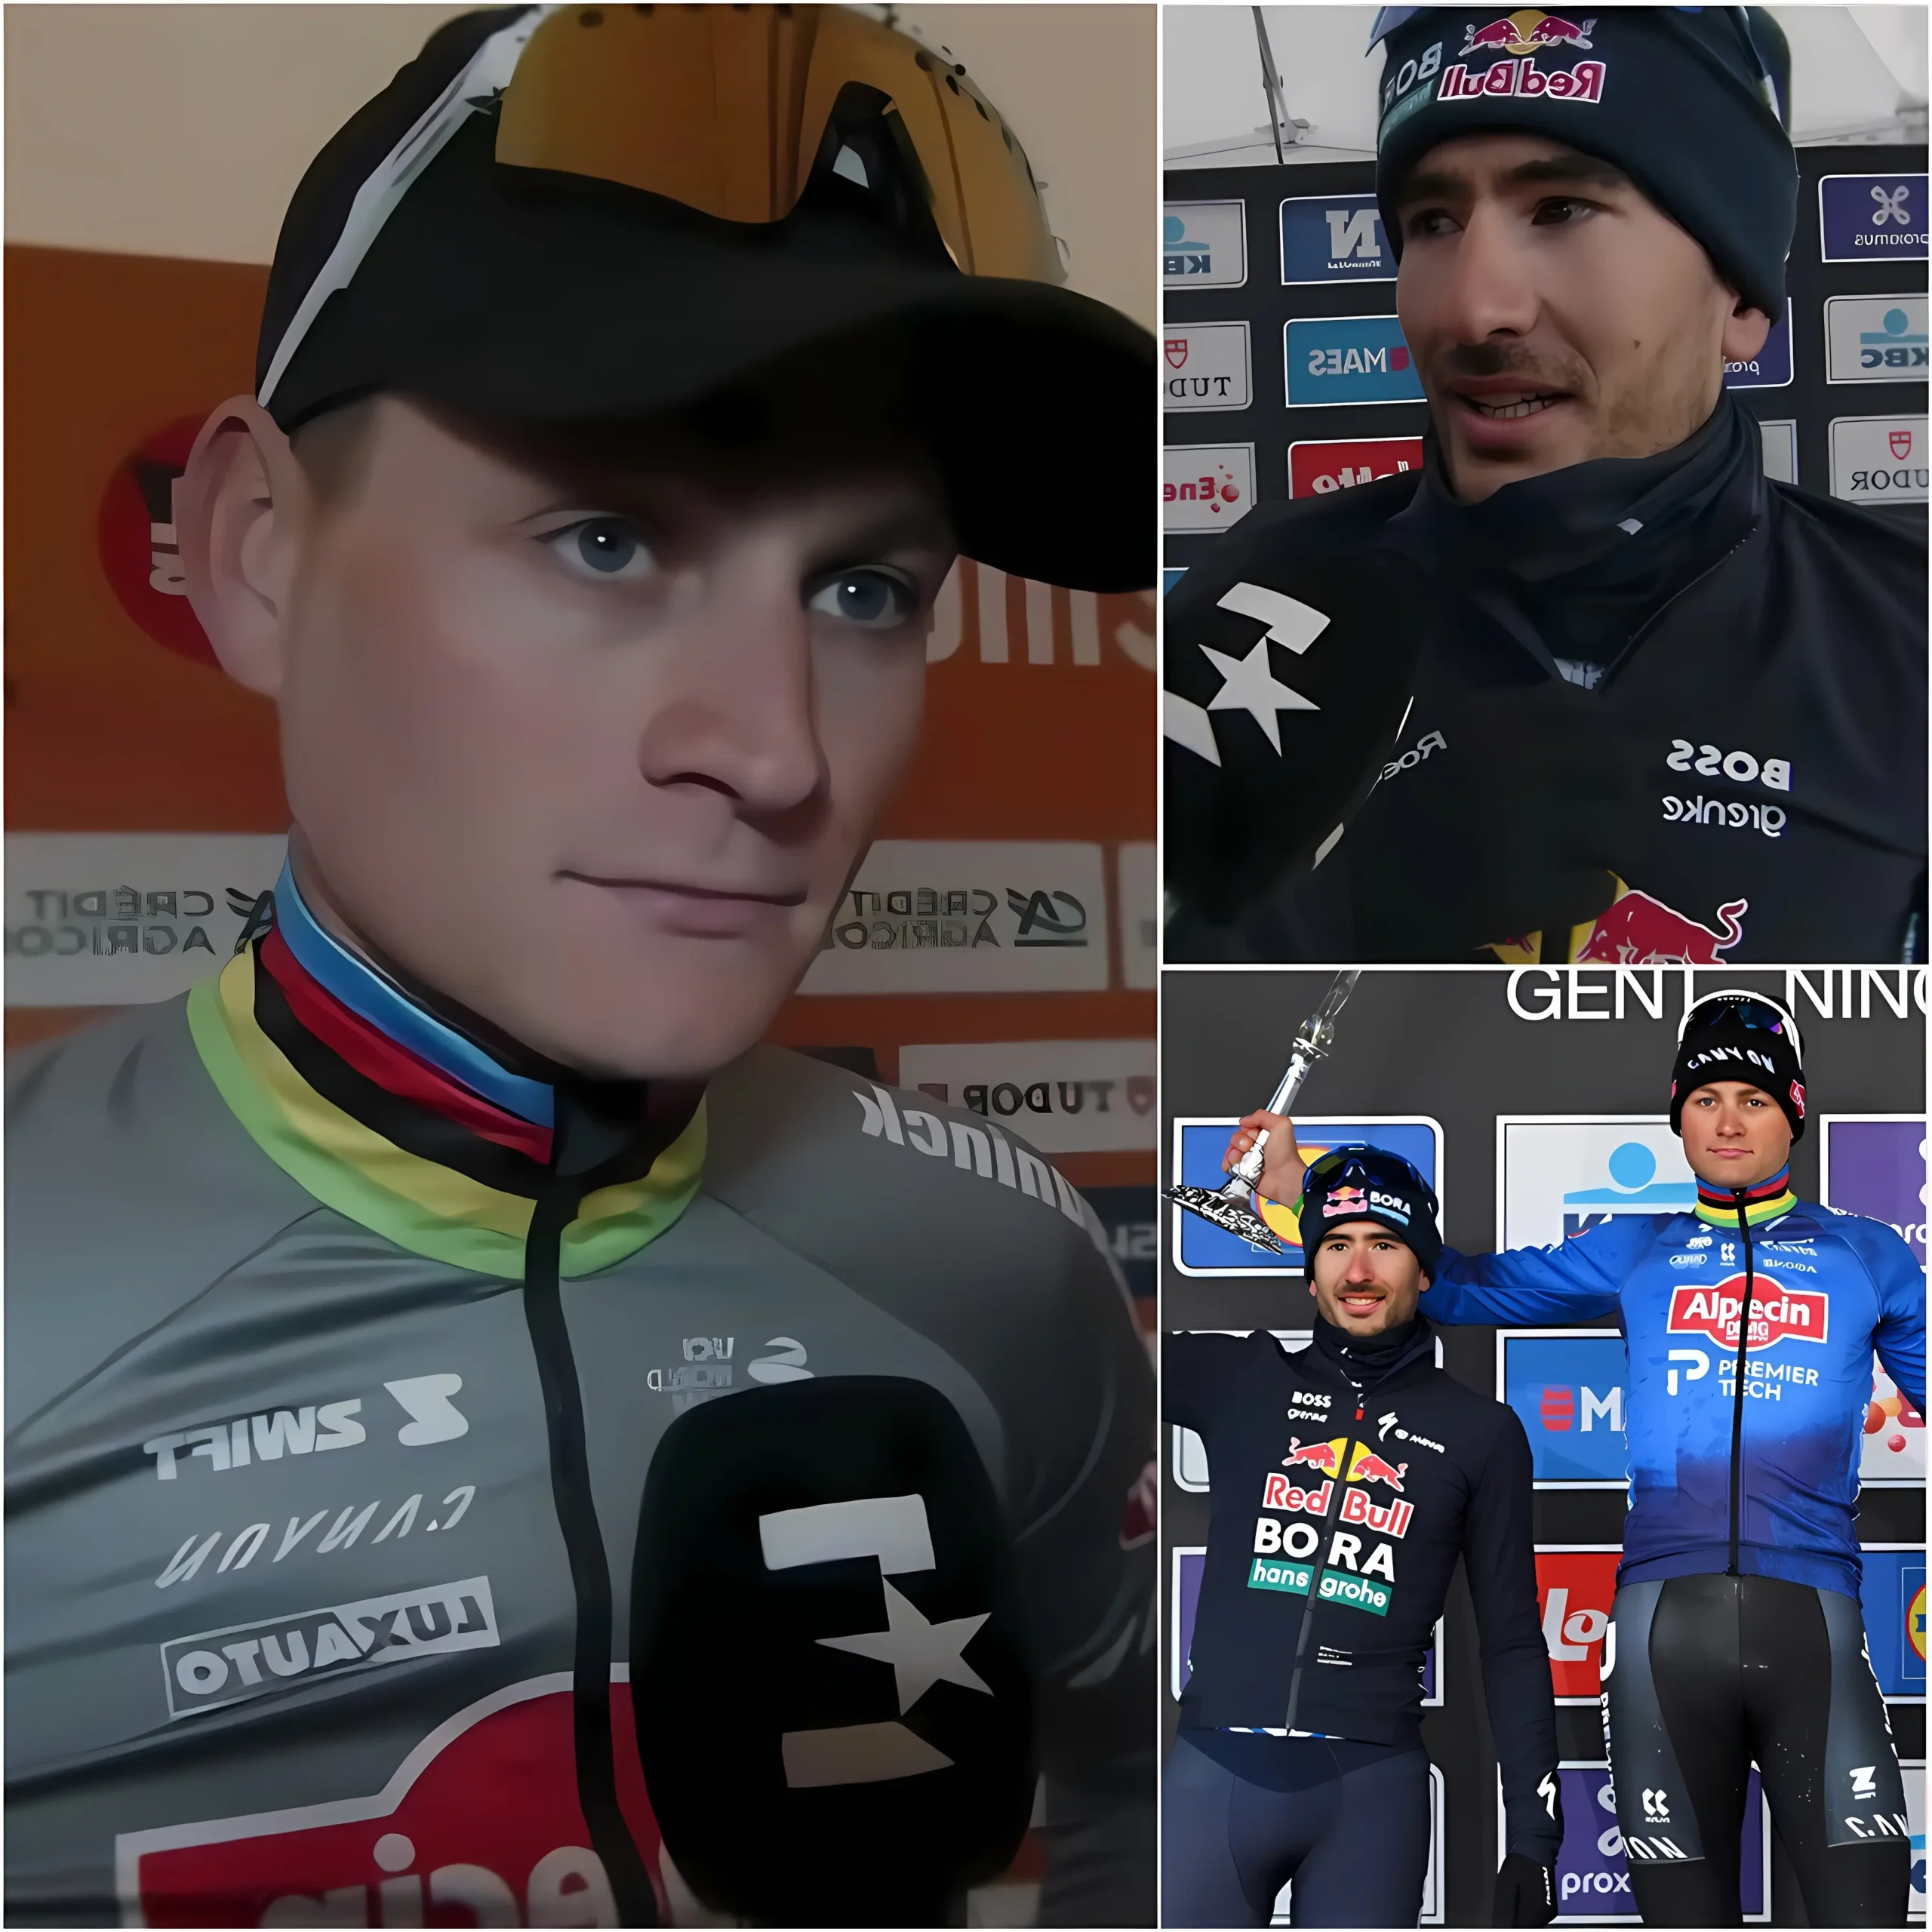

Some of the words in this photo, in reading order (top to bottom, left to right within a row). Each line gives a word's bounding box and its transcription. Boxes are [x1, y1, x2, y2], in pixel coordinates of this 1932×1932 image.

[1682, 1291, 1810, 1329] Alpecin
[1718, 1358, 1819, 1386] PREMIER
[1718, 1379, 1782, 1401] TECH
[1580, 1386, 1622, 1431] M
[1262, 1472, 1334, 1516] Red
[1338, 1487, 1415, 1539] Bull
[1561, 1872, 1632, 1901] prox
